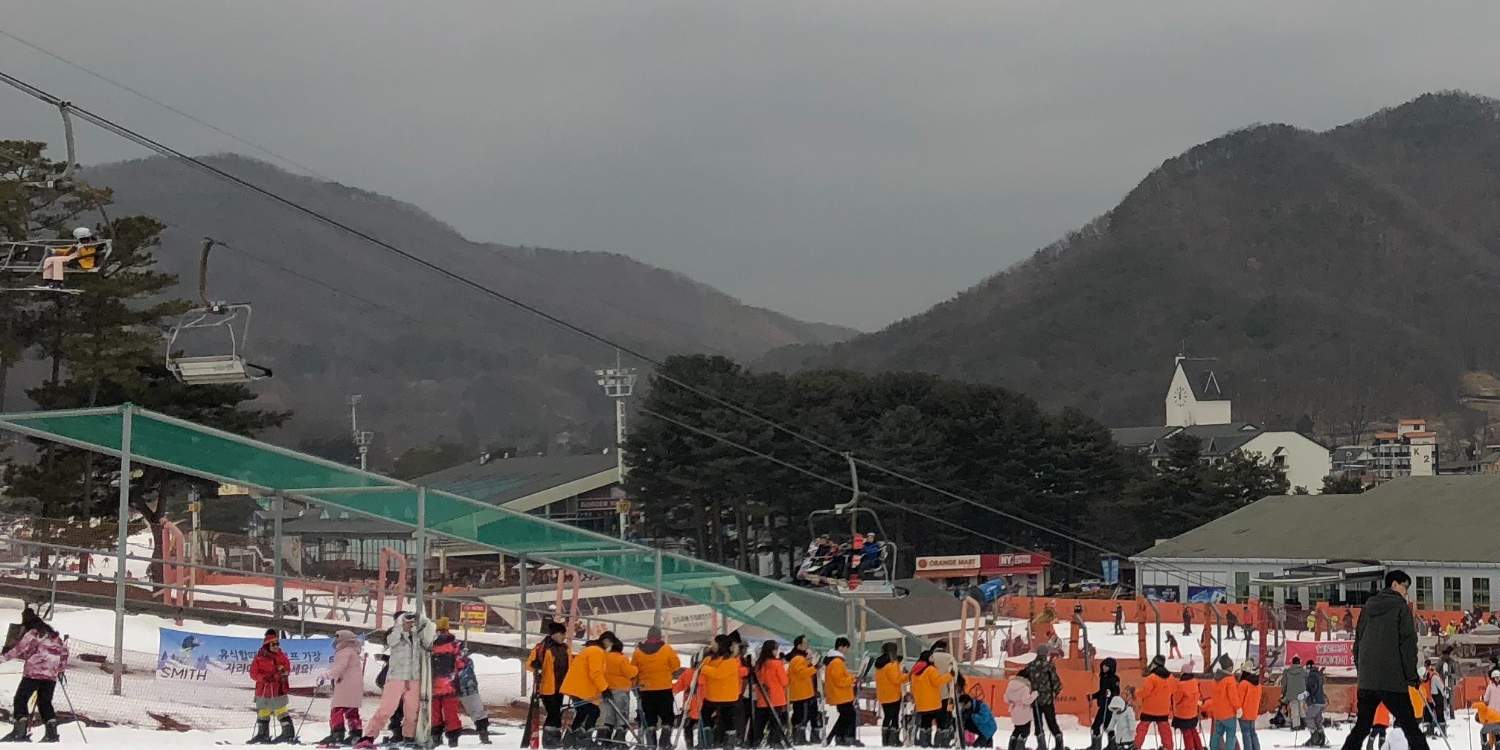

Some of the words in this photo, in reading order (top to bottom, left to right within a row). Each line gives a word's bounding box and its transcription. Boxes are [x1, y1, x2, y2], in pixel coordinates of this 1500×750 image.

[1413, 448, 1420, 456] K
[1423, 455, 1431, 463] 2
[928, 559, 957, 568] ORANGE
[958, 558, 976, 567] MART
[160, 666, 208, 681] SMITH
